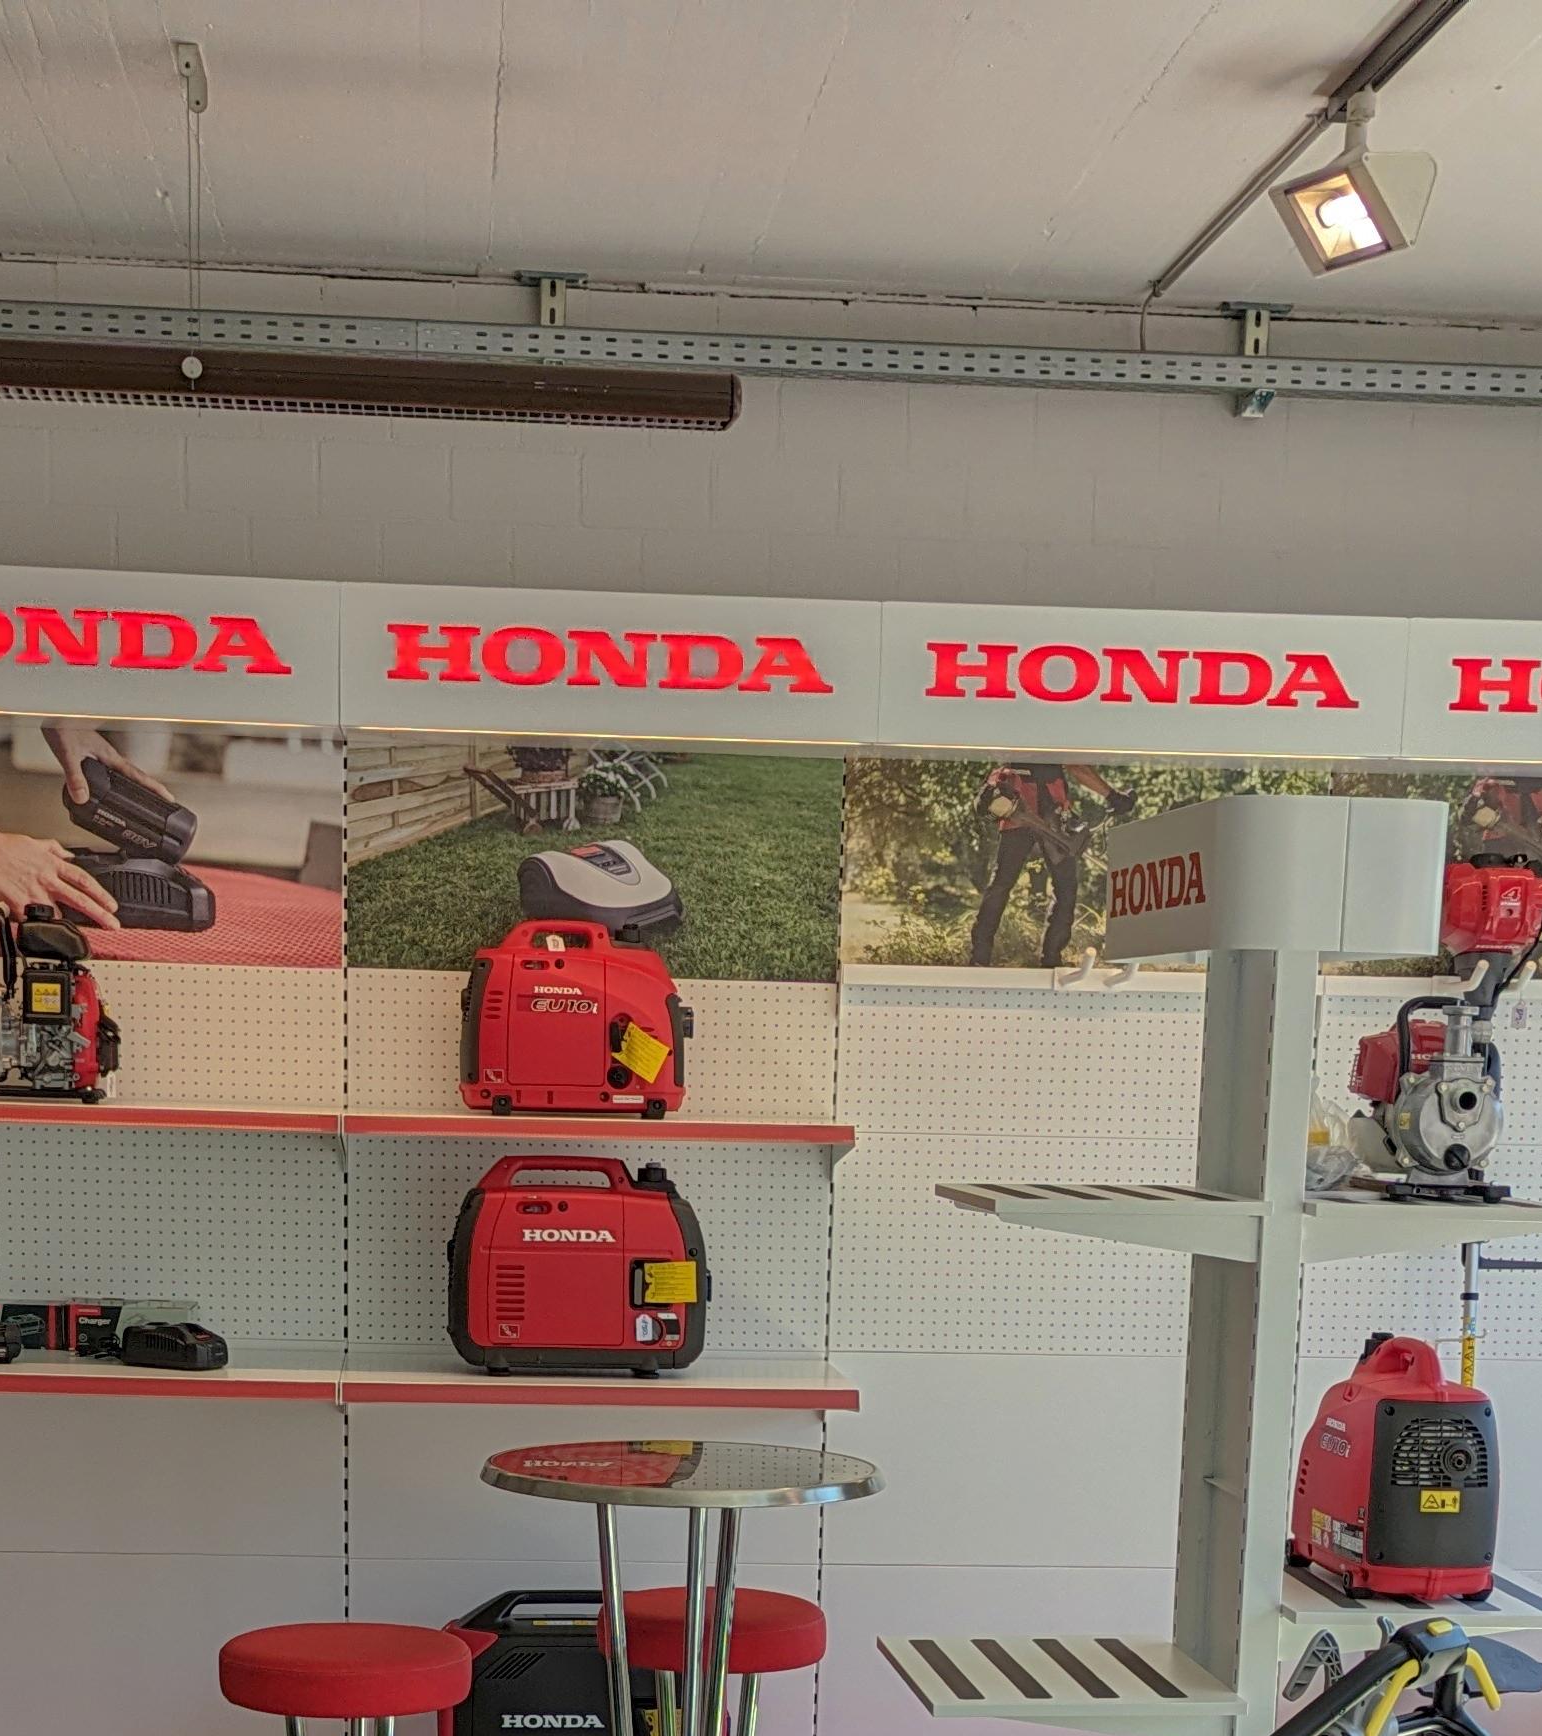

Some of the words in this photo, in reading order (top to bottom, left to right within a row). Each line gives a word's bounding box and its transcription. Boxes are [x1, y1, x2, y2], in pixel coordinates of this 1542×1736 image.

[386, 623, 833, 693] HONDA
[925, 641, 1360, 710] HONDA
[1110, 852, 1206, 918] HONDA
[534, 985, 583, 995] HONDA
[531, 998, 598, 1015] EU10i
[522, 1229, 616, 1242] HONDA
[78, 1316, 111, 1327] Charger
[500, 1714, 605, 1729] HONDA
